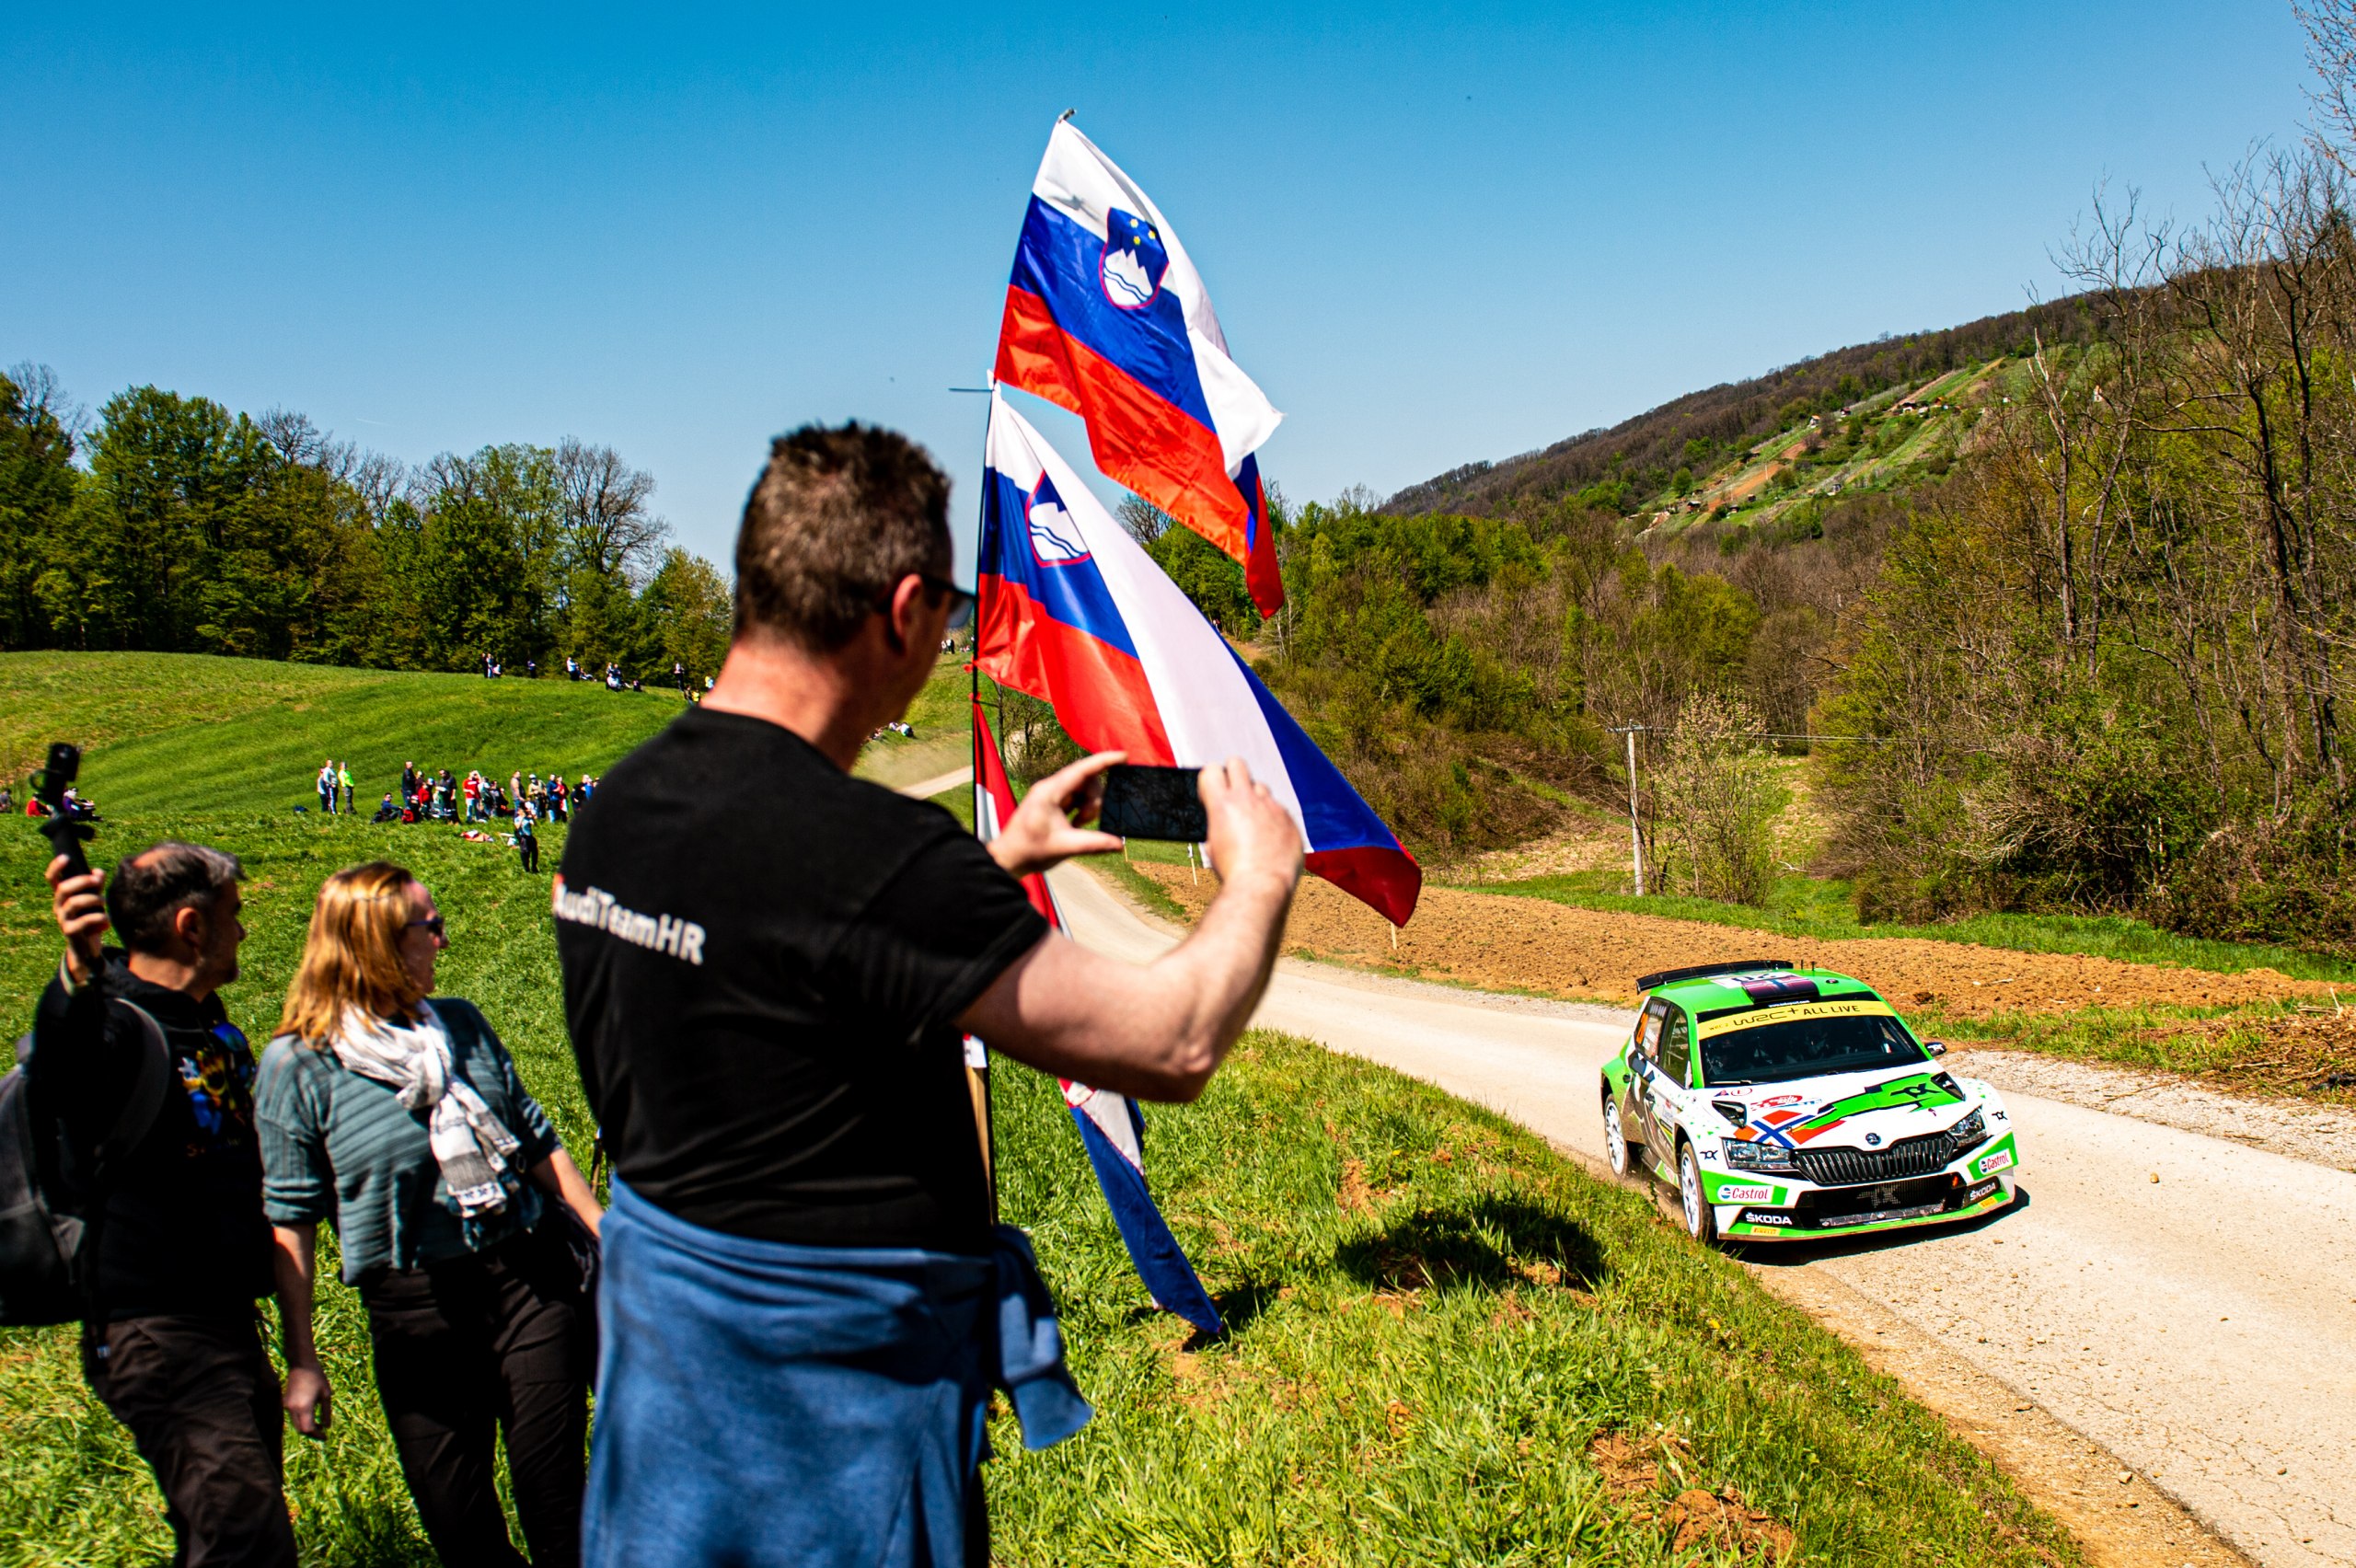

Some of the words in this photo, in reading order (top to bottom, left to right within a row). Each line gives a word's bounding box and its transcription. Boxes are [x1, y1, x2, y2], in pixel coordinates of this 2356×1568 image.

[1803, 1008, 1828, 1016] ALL
[1831, 1005, 1861, 1013] LIVE
[1987, 1152, 2009, 1170] Castrol
[1732, 1187, 1768, 1199] Castrol
